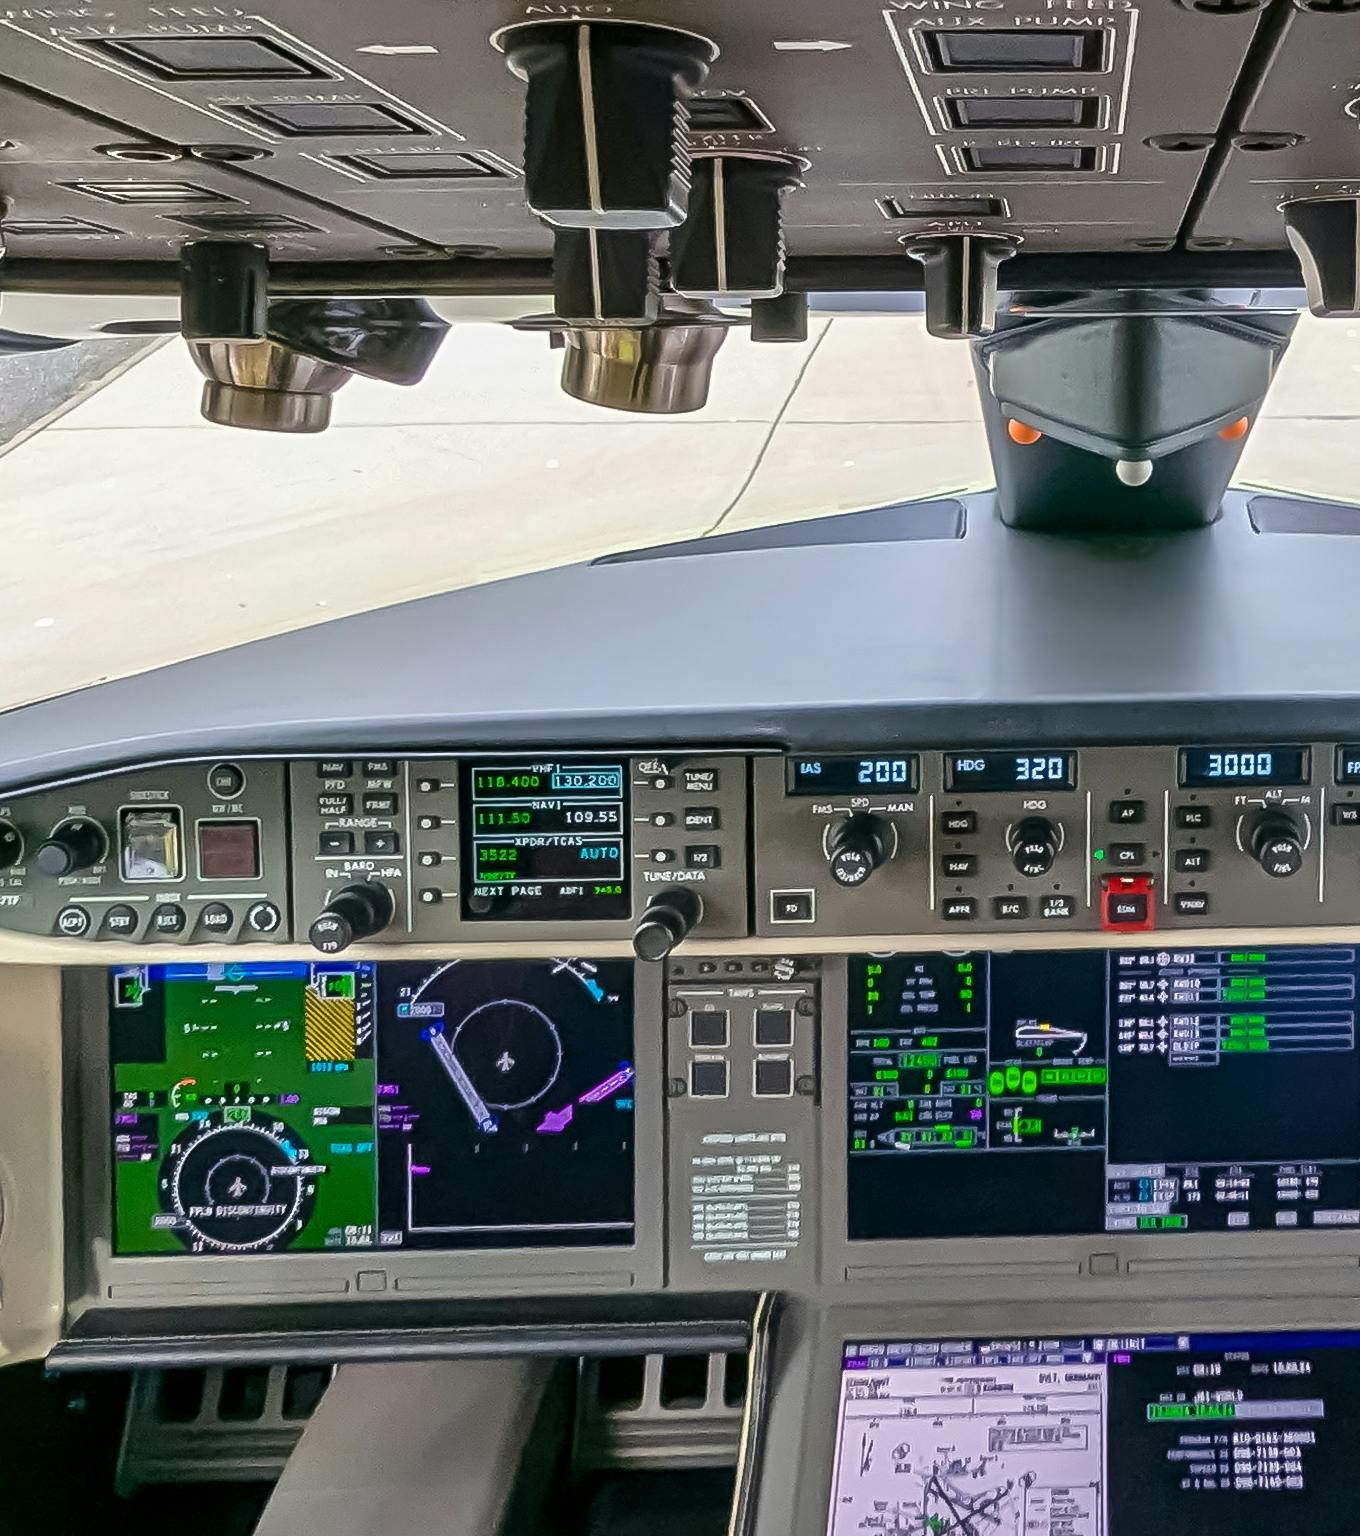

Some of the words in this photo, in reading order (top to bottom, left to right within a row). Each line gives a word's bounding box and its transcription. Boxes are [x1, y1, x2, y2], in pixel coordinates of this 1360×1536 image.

[911, 15, 986, 27] AUX
[1013, 14, 1117, 27] PUMP
[956, 759, 986, 771] HDG
[1015, 757, 1064, 781] 320
[1208, 752, 1273, 777] 3000
[800, 762, 823, 775] IAS
[857, 760, 908, 783] 200
[324, 780, 346, 790] PFD
[477, 775, 540, 788] 118.400
[554, 774, 618, 787] 130.200
[686, 782, 713, 791] MENU
[1265, 789, 1283, 800] ALT
[319, 796, 347, 805] FULL/
[531, 800, 562, 811] NAV1
[850, 797, 870, 808] SPD
[1023, 799, 1048, 811] HDG
[1234, 795, 1247, 806] FT
[320, 805, 347, 815] HALF
[811, 804, 834, 814] FMS
[886, 802, 915, 813] MAN
[1120, 808, 1135, 818] AP
[338, 818, 378, 828] RANGE
[478, 812, 531, 826] 111.50
[565, 810, 619, 824] 109.55
[685, 815, 713, 825] IDENT
[948, 819, 969, 829] HDG
[513, 836, 584, 847] XPDR/TCAS
[479, 848, 518, 862] 3522
[579, 846, 620, 860] AUTO
[1118, 850, 1136, 861] CPL
[343, 862, 376, 872] BARO
[1184, 857, 1202, 866] ALT
[643, 870, 706, 883] TUNE/DATA
[473, 885, 504, 897] NEXT
[511, 885, 543, 896] PAGE
